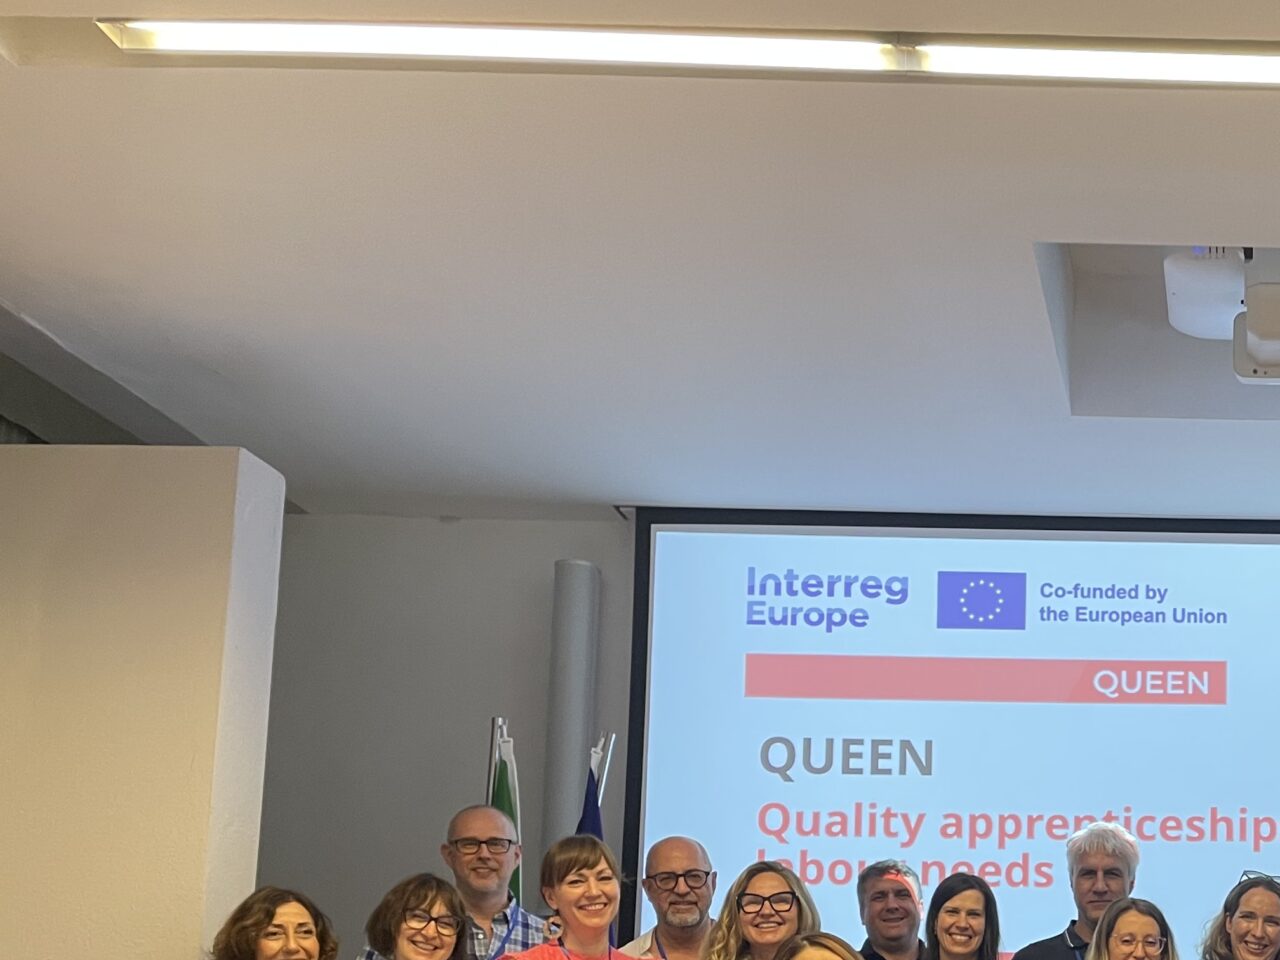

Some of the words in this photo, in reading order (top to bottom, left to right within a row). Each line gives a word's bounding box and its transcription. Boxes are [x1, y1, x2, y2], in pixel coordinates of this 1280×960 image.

[747, 566, 909, 605] Interreg
[1039, 582, 1139, 600] Co-funded
[1145, 584, 1168, 604] by
[746, 600, 870, 633] Europe
[1039, 605, 1069, 622] the
[1075, 606, 1166, 626] European
[1172, 607, 1228, 624] Union
[1092, 669, 1209, 699] QUEEN
[759, 736, 933, 782] QUEEN
[757, 801, 927, 848] Quality
